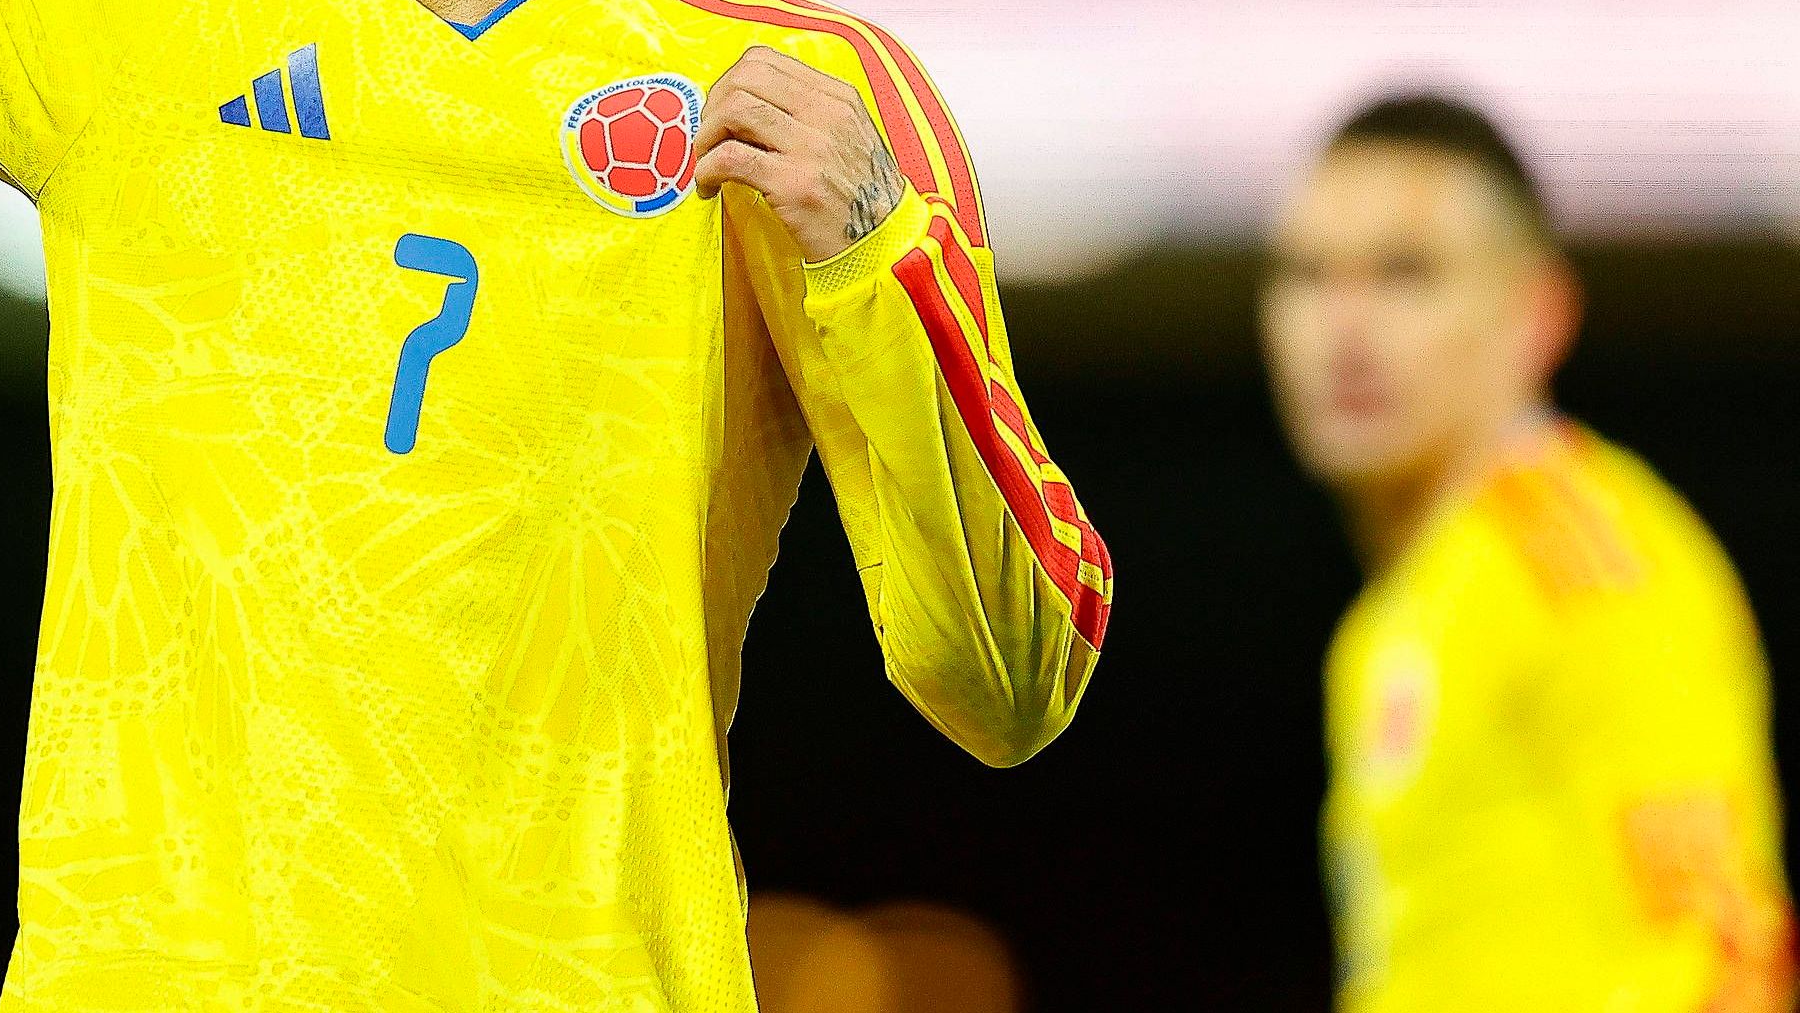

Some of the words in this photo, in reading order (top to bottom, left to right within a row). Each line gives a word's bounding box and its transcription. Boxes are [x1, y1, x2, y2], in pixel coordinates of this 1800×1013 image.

[626, 77, 688, 93] COLOMBIANA
[683, 88, 696, 100] DE
[384, 232, 479, 455] 7
